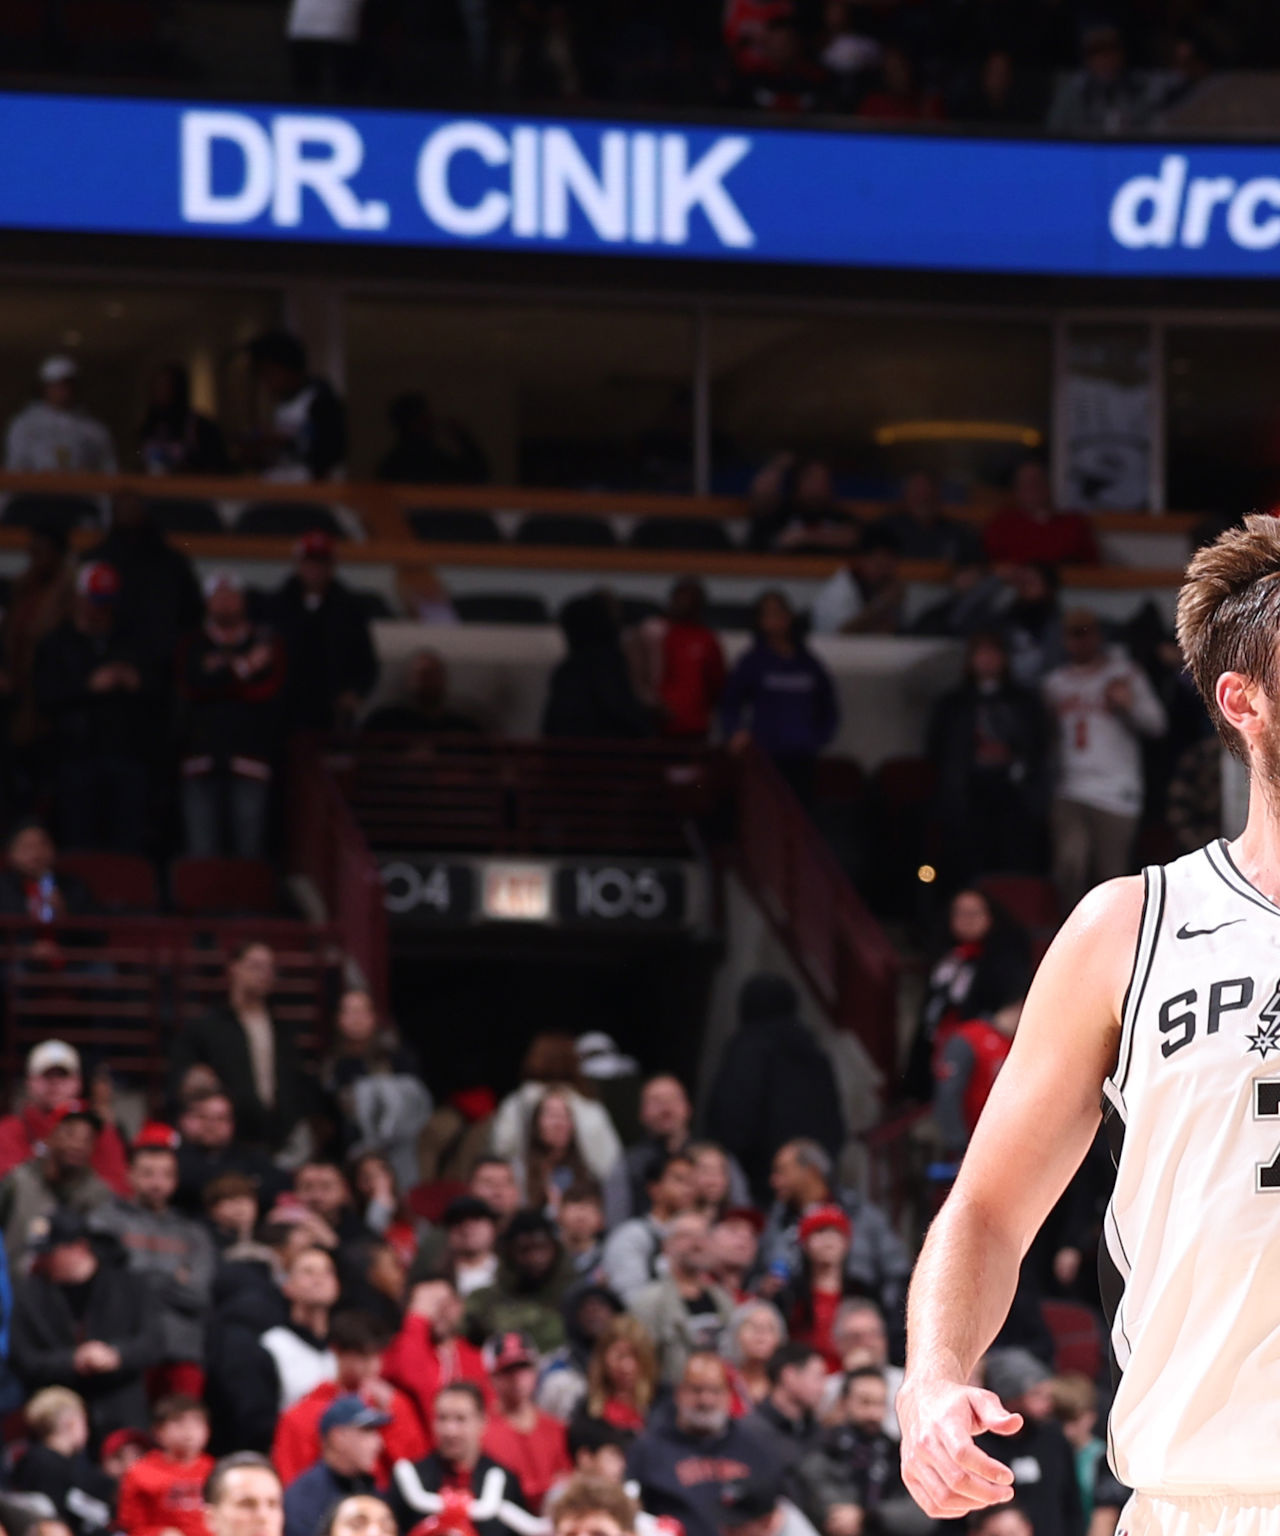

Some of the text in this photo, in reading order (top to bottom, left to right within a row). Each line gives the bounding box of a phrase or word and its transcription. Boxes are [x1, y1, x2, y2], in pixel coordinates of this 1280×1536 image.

[181, 110, 756, 250] DR. CINIK
[381, 861, 448, 914] 04
[575, 866, 667, 919] 105
